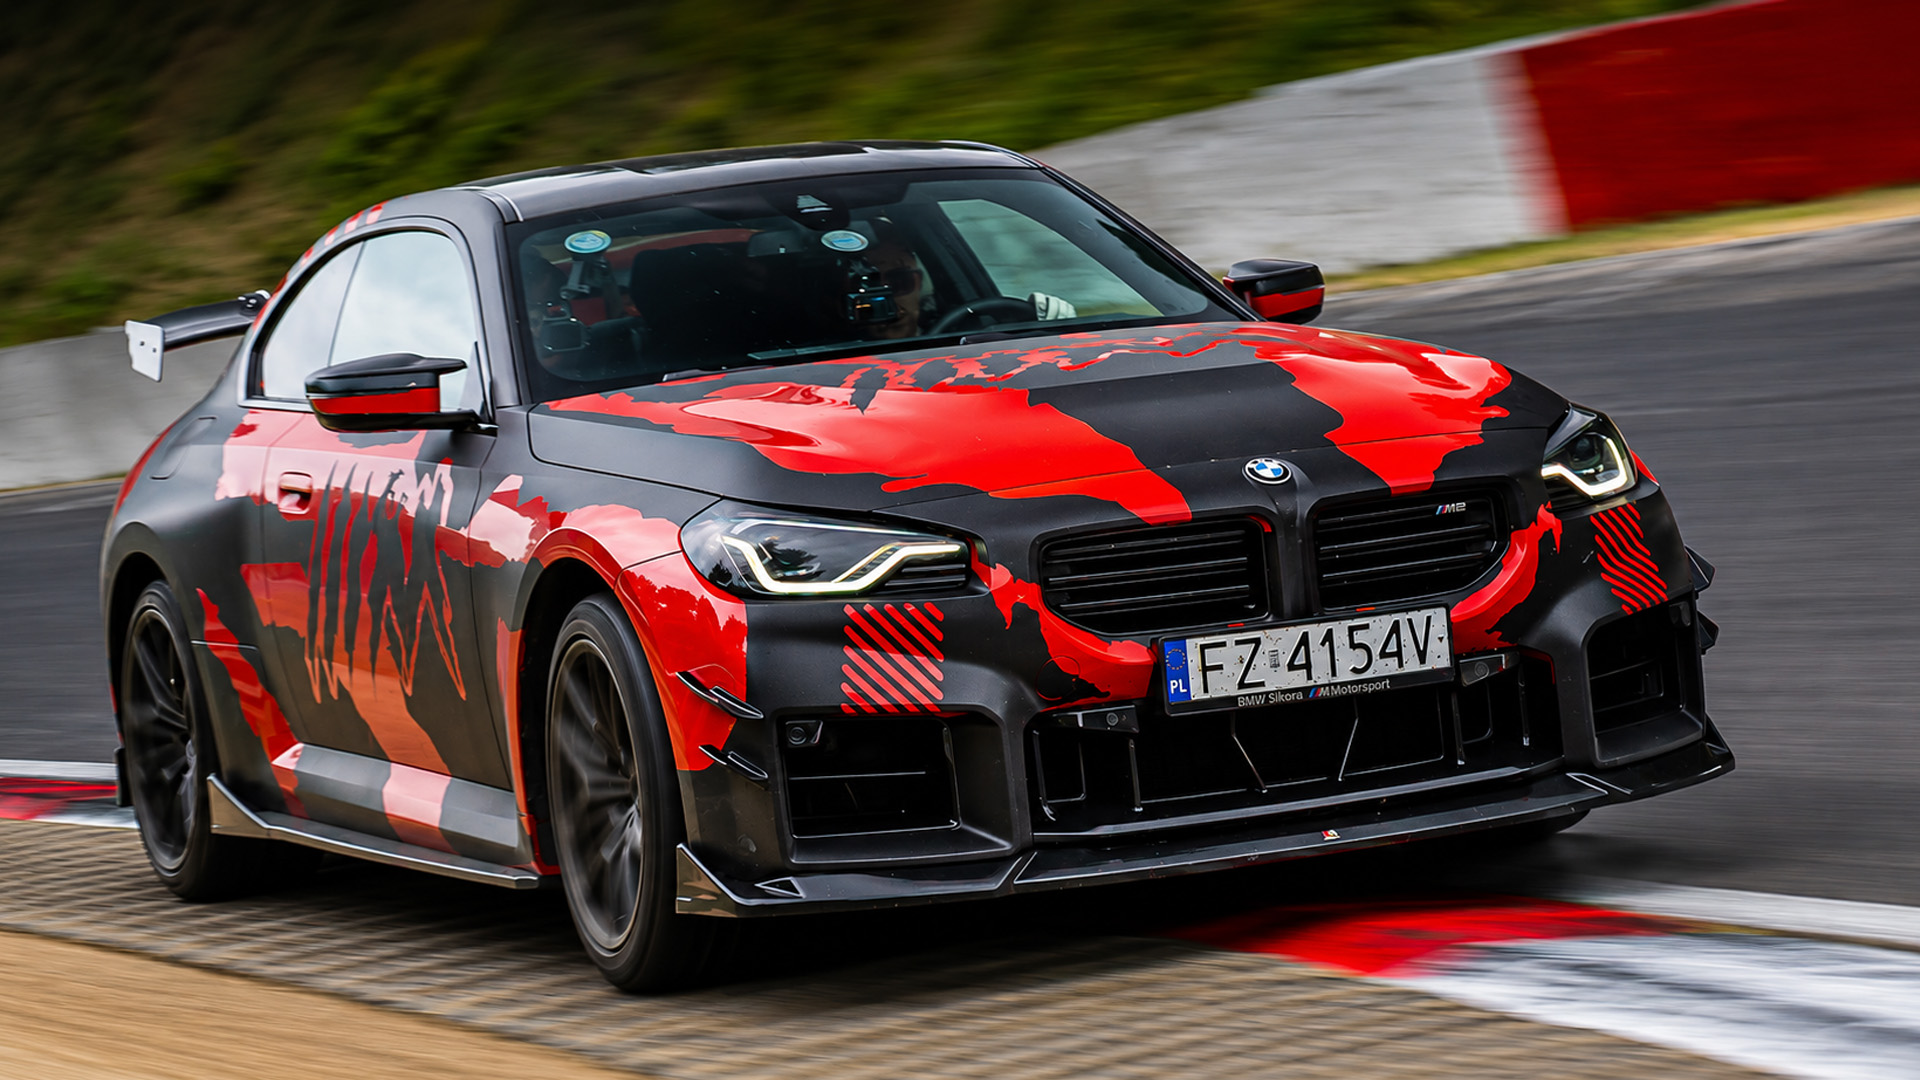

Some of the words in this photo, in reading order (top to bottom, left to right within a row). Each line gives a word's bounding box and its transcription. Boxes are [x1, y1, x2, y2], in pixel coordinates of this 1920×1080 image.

[1440, 501, 1467, 515] M2
[1199, 636, 1266, 694] FZ
[1286, 615, 1432, 682] 4154V
[1170, 678, 1188, 694] PL
[1237, 693, 1266, 707] BMW
[1268, 690, 1303, 704] Sikora
[1331, 678, 1391, 696] Motorsport
